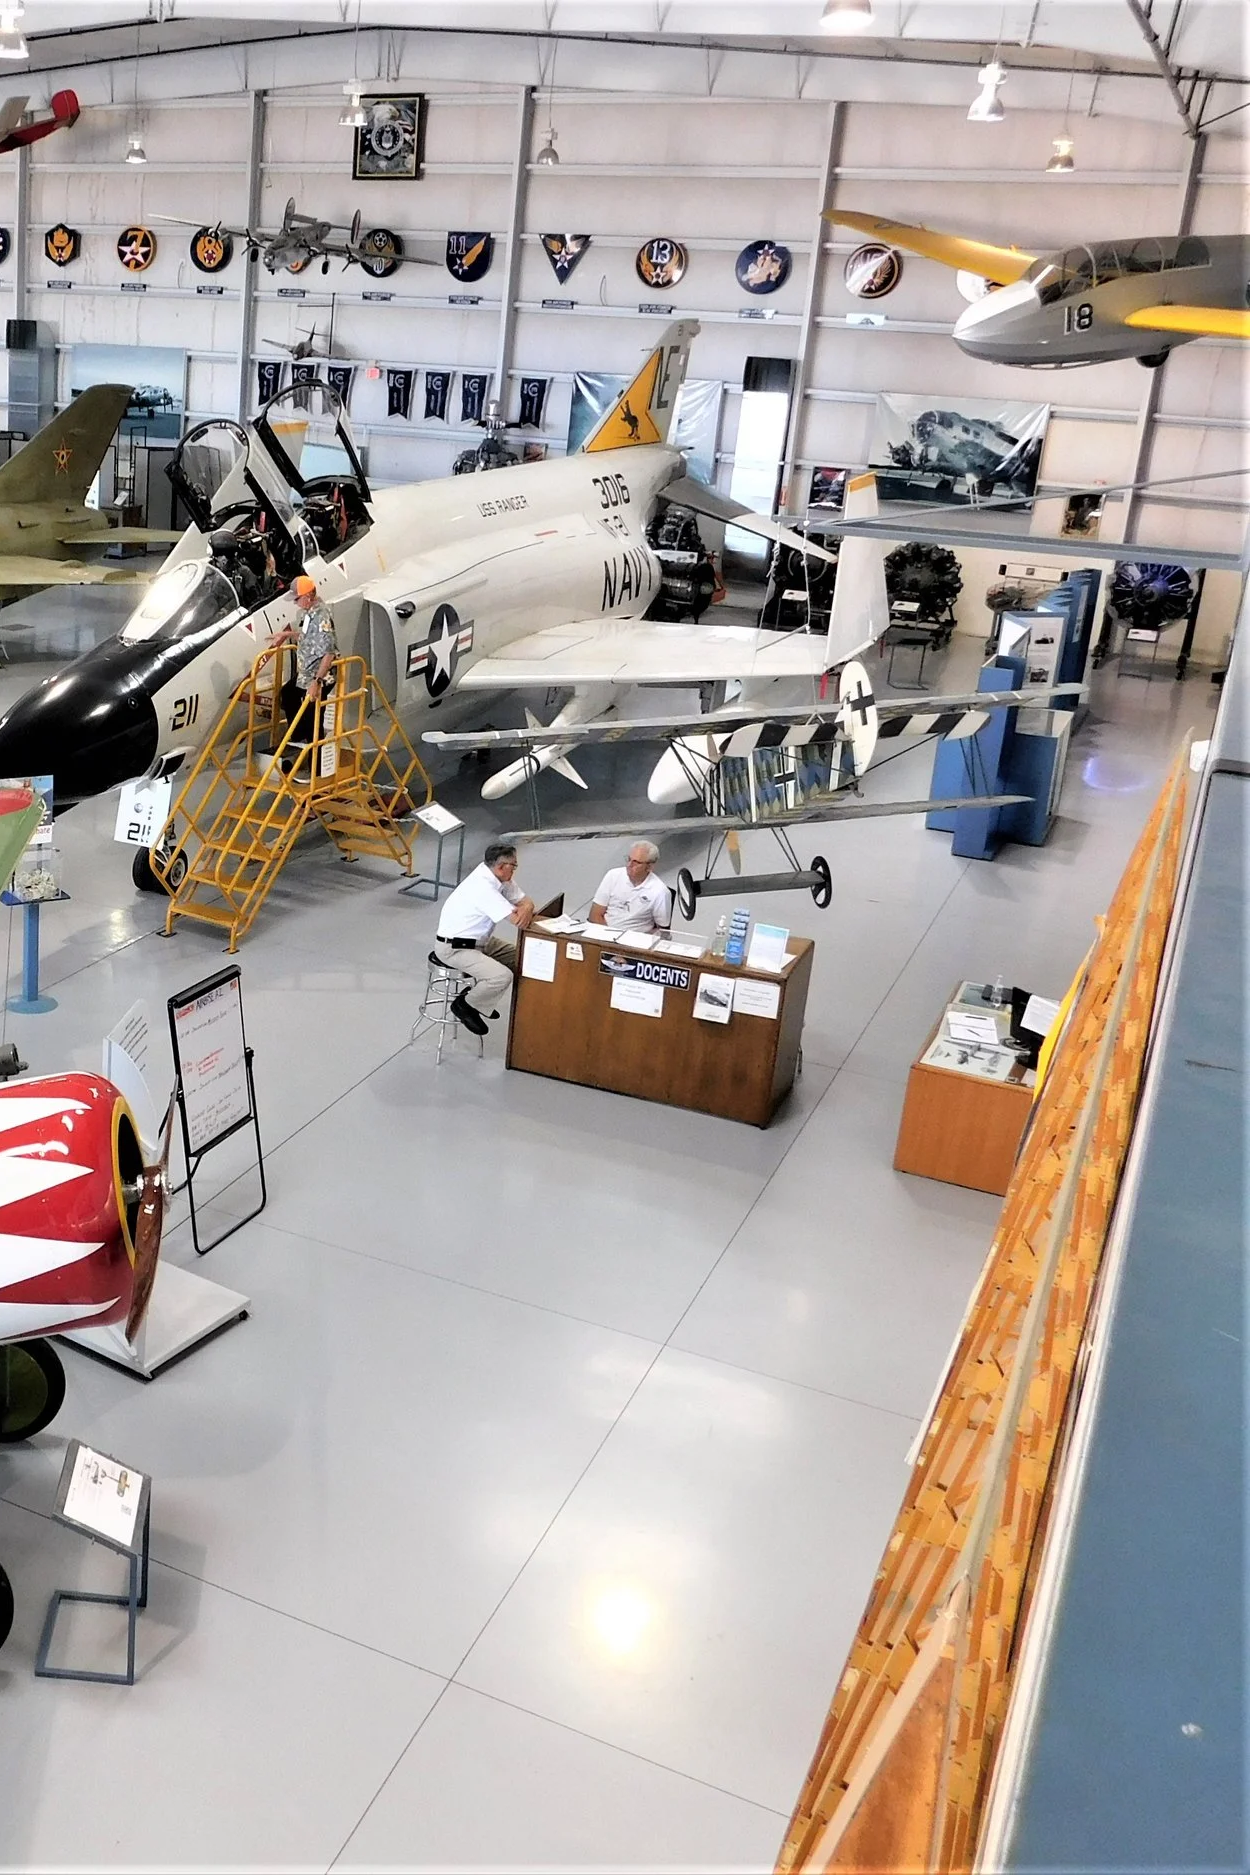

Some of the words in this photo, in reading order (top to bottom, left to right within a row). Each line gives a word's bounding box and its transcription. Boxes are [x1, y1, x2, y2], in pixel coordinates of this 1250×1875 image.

[449, 235, 467, 255] 11
[650, 240, 671, 264] 13
[1063, 302, 1094, 335] 18
[476, 501, 498, 518] USS
[494, 494, 530, 513] RANGER
[592, 473, 631, 509] 3016
[600, 544, 652, 612] NAVY
[171, 693, 199, 732] 211
[635, 961, 689, 988] DOCENTS
